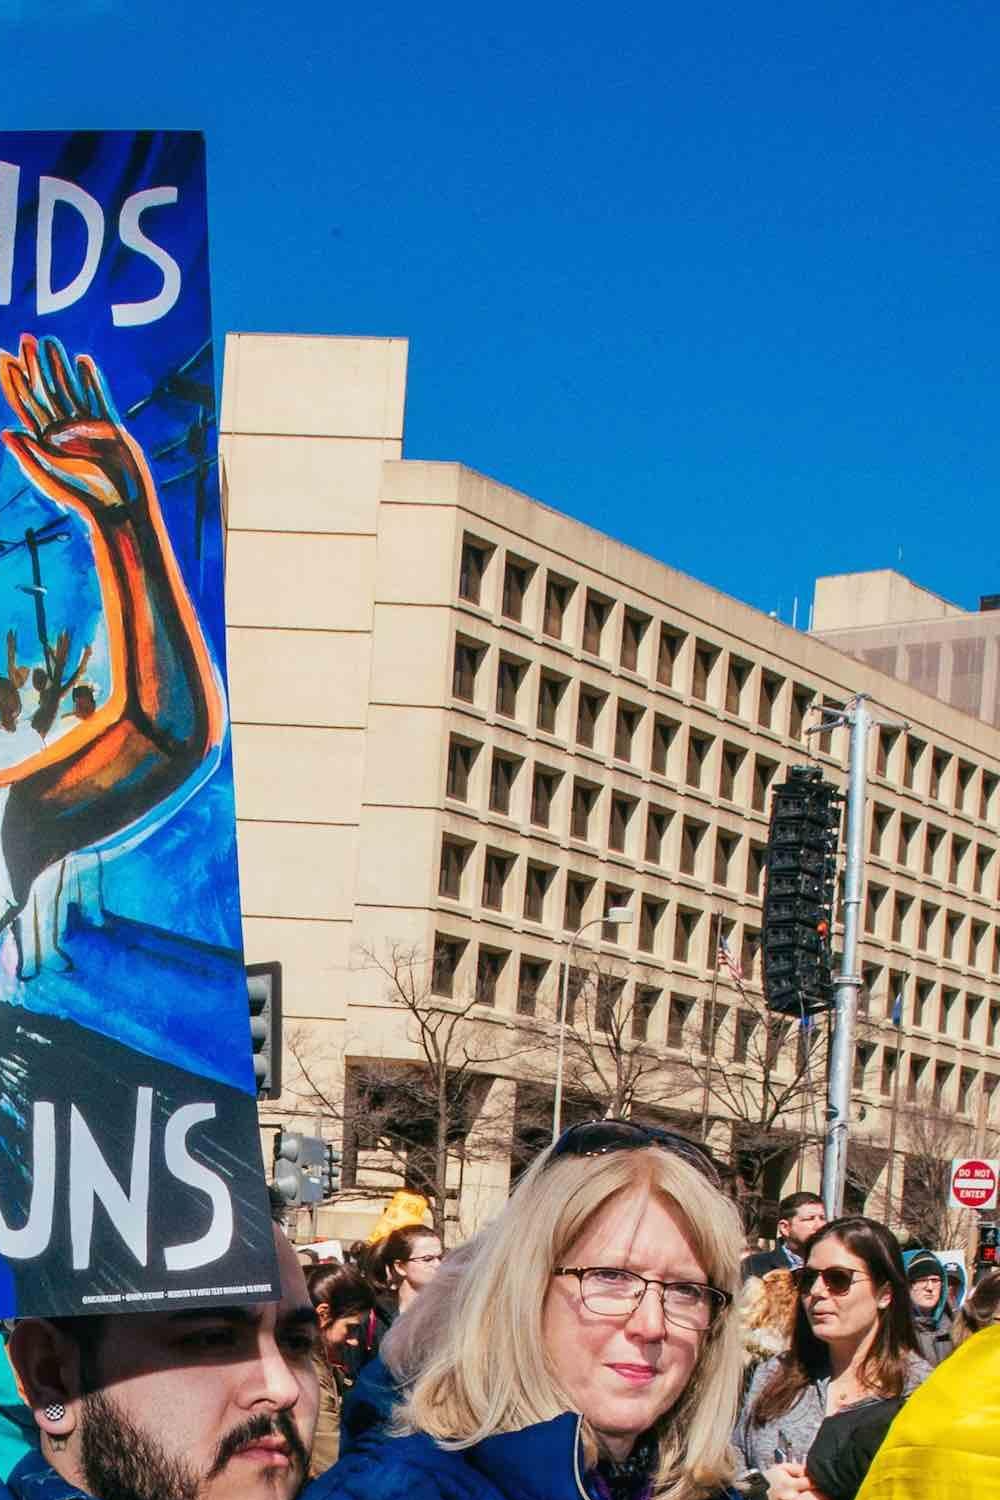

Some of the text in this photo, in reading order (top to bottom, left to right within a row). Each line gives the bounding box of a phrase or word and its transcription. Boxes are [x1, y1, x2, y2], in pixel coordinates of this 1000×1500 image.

[958, 1168, 991, 1179] DO NOT
[959, 1190, 987, 1200] ENTER
